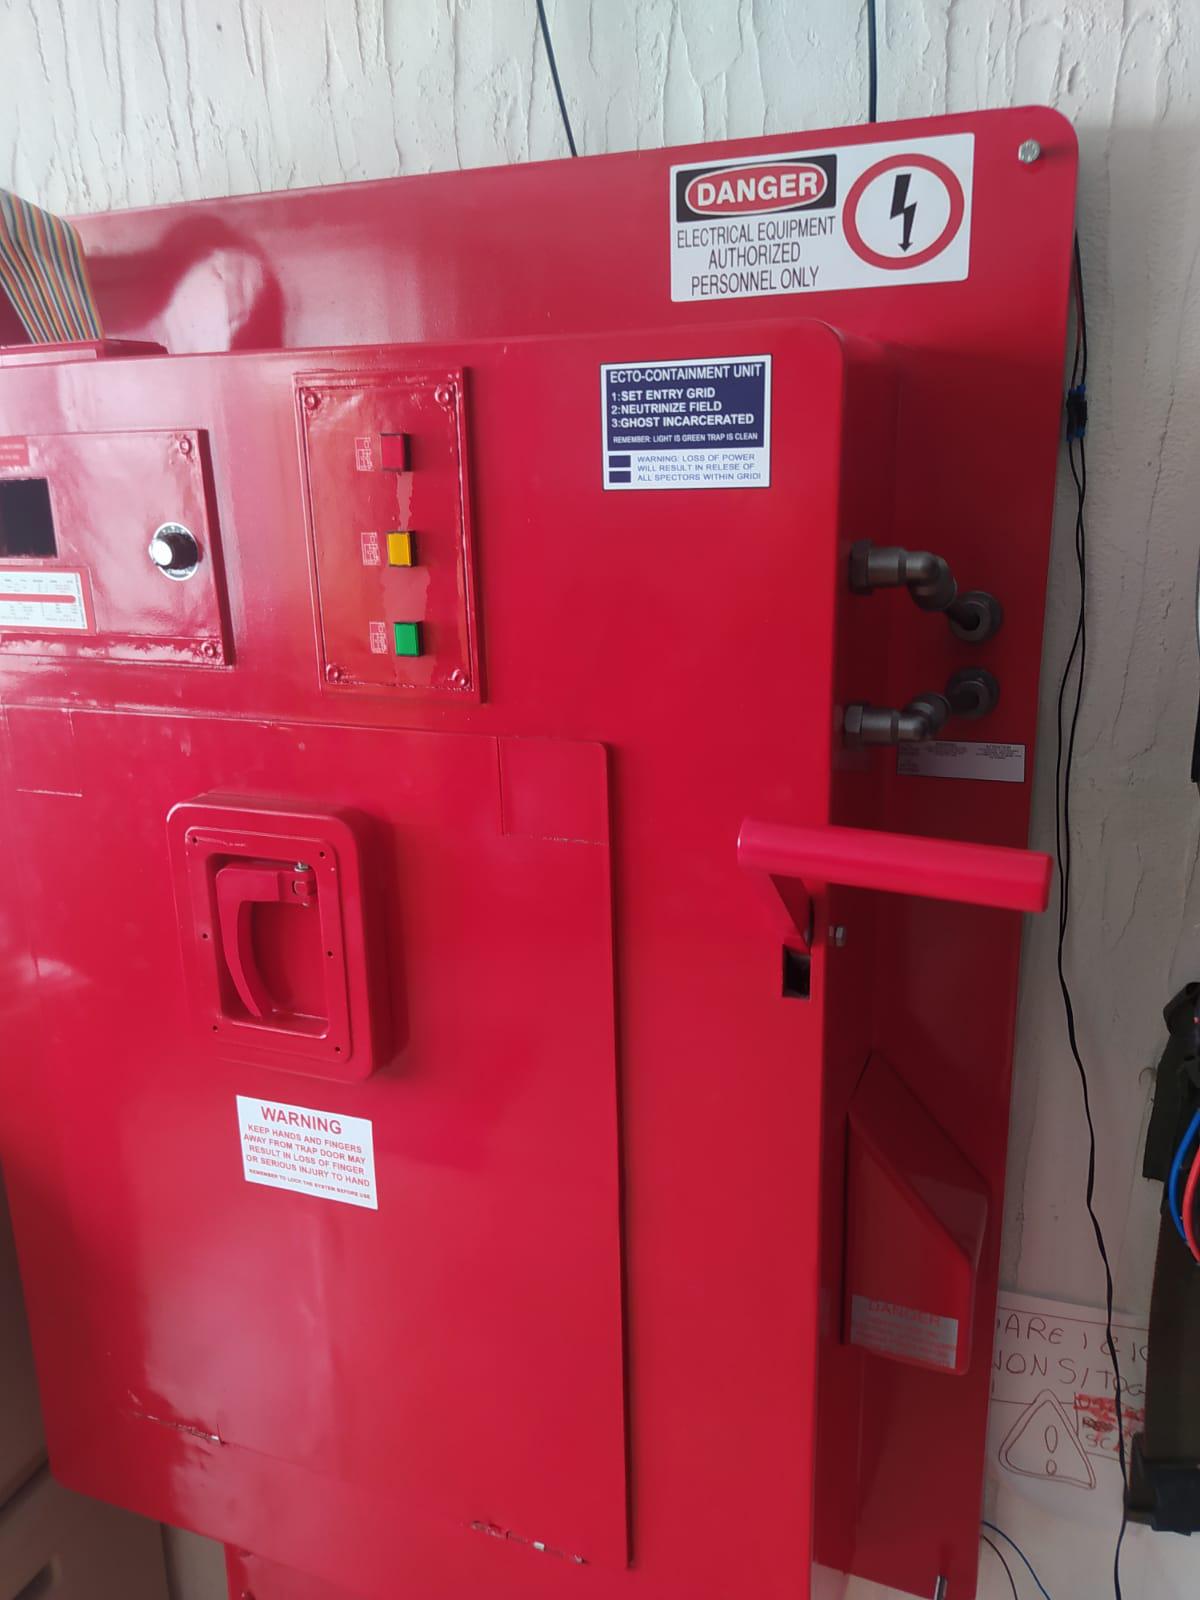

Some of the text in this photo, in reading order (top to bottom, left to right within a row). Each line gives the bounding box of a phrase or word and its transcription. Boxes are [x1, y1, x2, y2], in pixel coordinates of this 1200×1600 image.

[697, 171, 818, 207] DANGER
[676, 216, 836, 249] ELECTRICAL EQUIPMENT
[708, 241, 800, 270] AUTHORIZED
[691, 266, 819, 296] PERSONNEL ONLY
[610, 363, 762, 384] ECTO-CONTAINMENT UNIT
[611, 386, 716, 402] 1:SET ENTRY GRID
[611, 400, 722, 415] 2:NEUTRINIZE FIELD
[611, 413, 755, 428] 3:GHOST INCARCERATED
[652, 434, 672, 443] LIGHT
[673, 434, 681, 442] IS
[681, 433, 706, 442] GREEN
[707, 433, 725, 441] TRAP
[726, 432, 734, 440] IS
[734, 431, 758, 440] CLEAN
[637, 462, 755, 472] WILL RESULT IN RELESE OF
[682, 454, 706, 463] LOSS
[707, 454, 720, 462] OF
[722, 453, 755, 461] POWER
[637, 474, 652, 482] ALL
[654, 473, 701, 481] SPECTORS
[703, 472, 735, 480] WITHIN
[261, 1106, 342, 1135] WARNING
[244, 1133, 366, 1165] AWAY FROM TRAP DOOR MAY
[247, 1123, 362, 1154] KEEP HANDS AND FINGERS
[246, 1154, 370, 1187] OR SERIOUS INJURY TO HAND
[249, 1145, 365, 1175] RESULT IN LOSS OF FINGER
